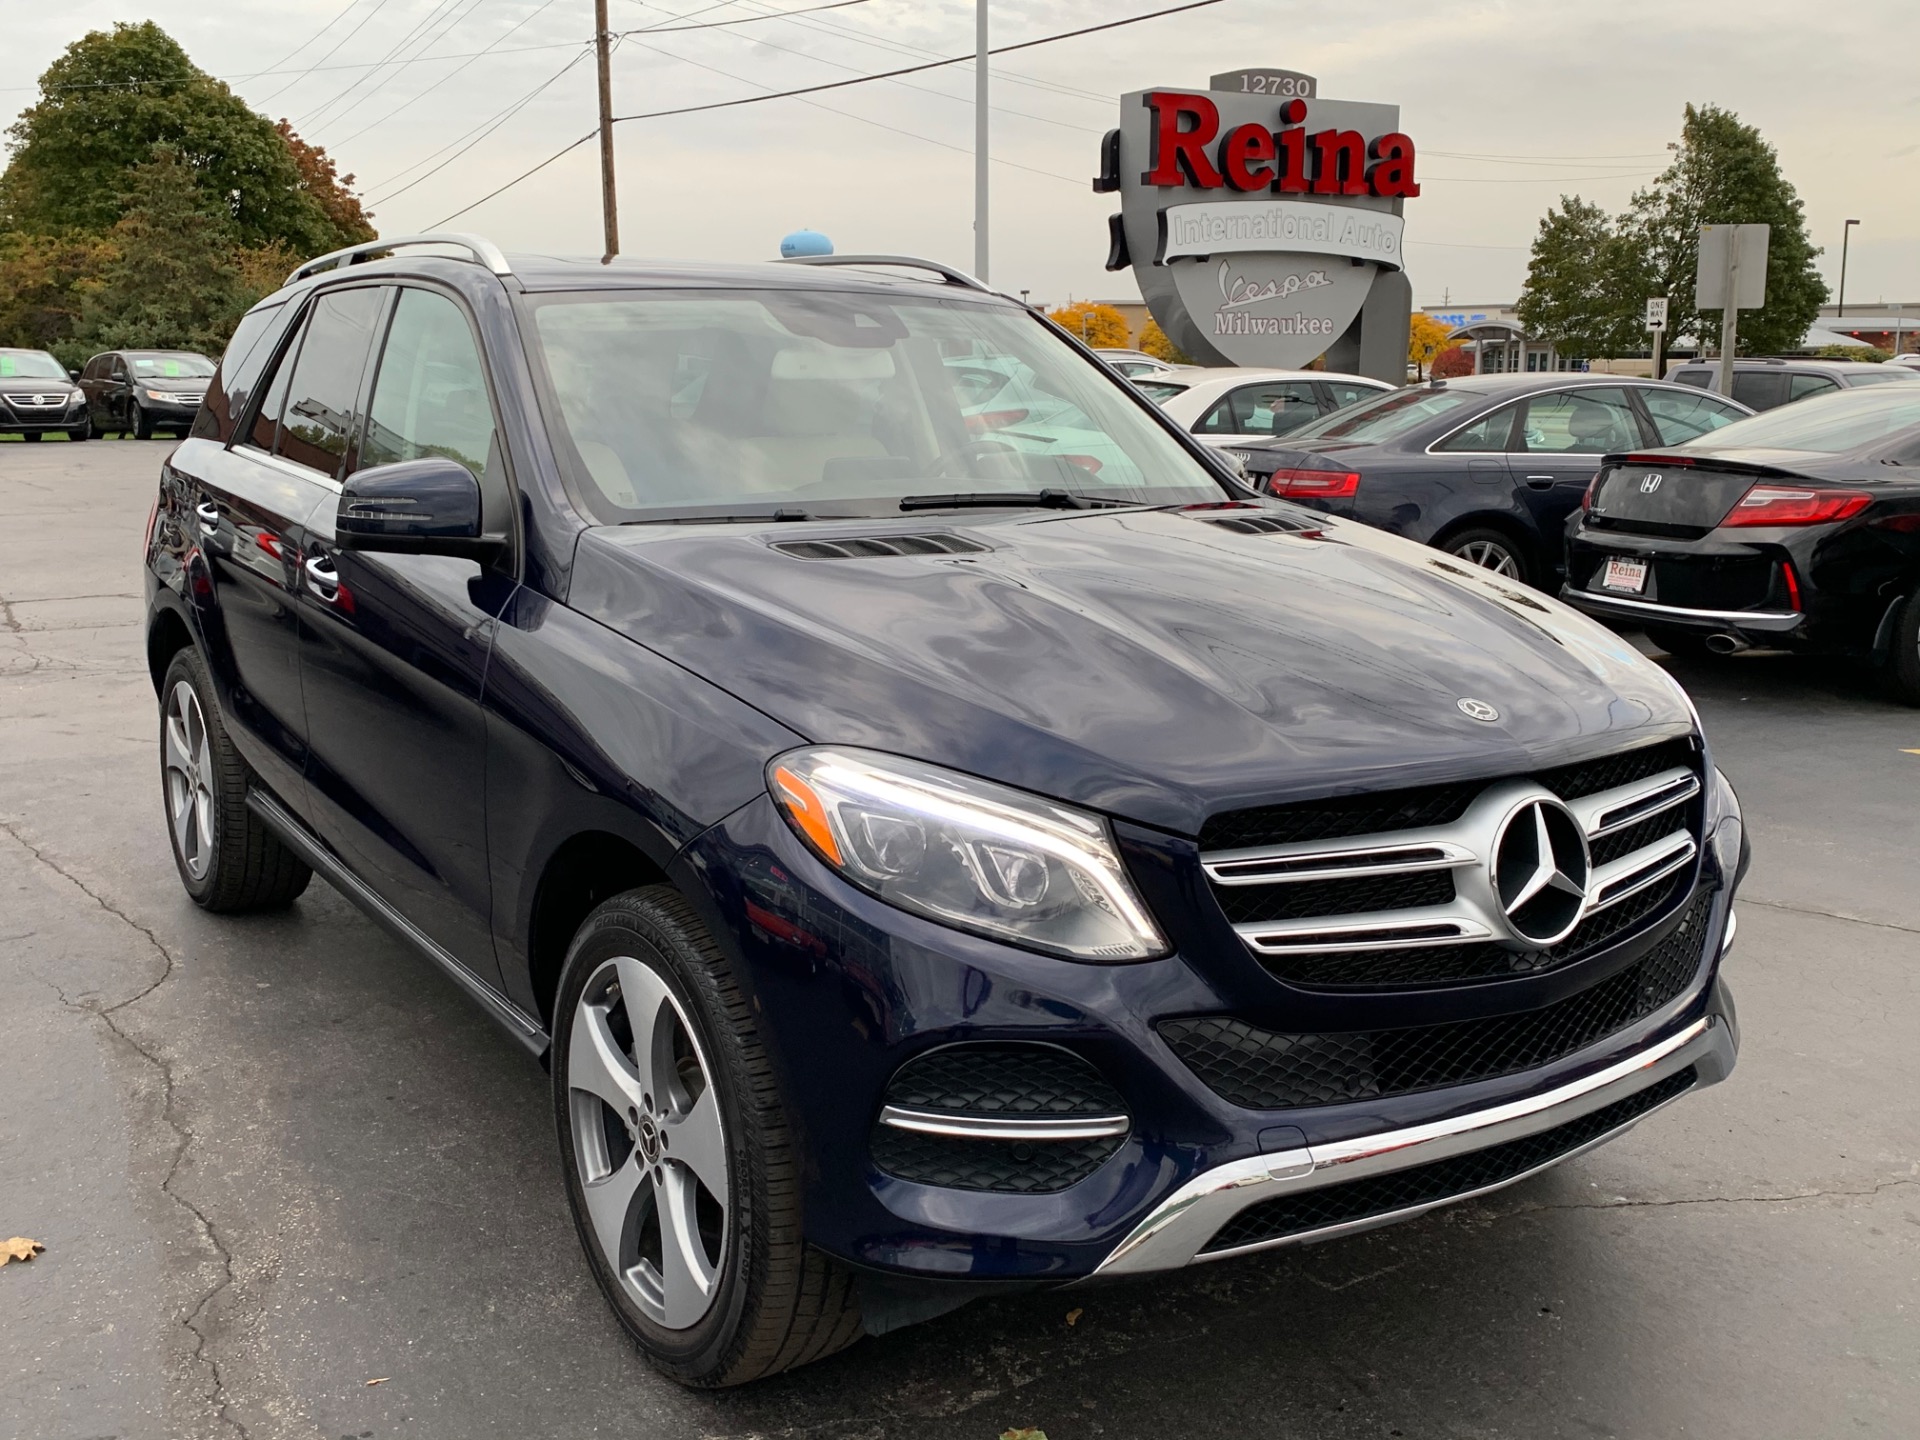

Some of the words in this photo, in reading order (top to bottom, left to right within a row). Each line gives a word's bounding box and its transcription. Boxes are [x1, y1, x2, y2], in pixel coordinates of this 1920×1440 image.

[1240, 73, 1311, 98] 12730
[1142, 91, 1420, 198] Reina
[1174, 208, 1335, 246] International
[1338, 215, 1397, 254] Auto
[1217, 258, 1334, 311] Vespa
[1650, 301, 1664, 309] ONE
[1213, 311, 1334, 336] Milwaukee
[1610, 562, 1642, 578] Reina
